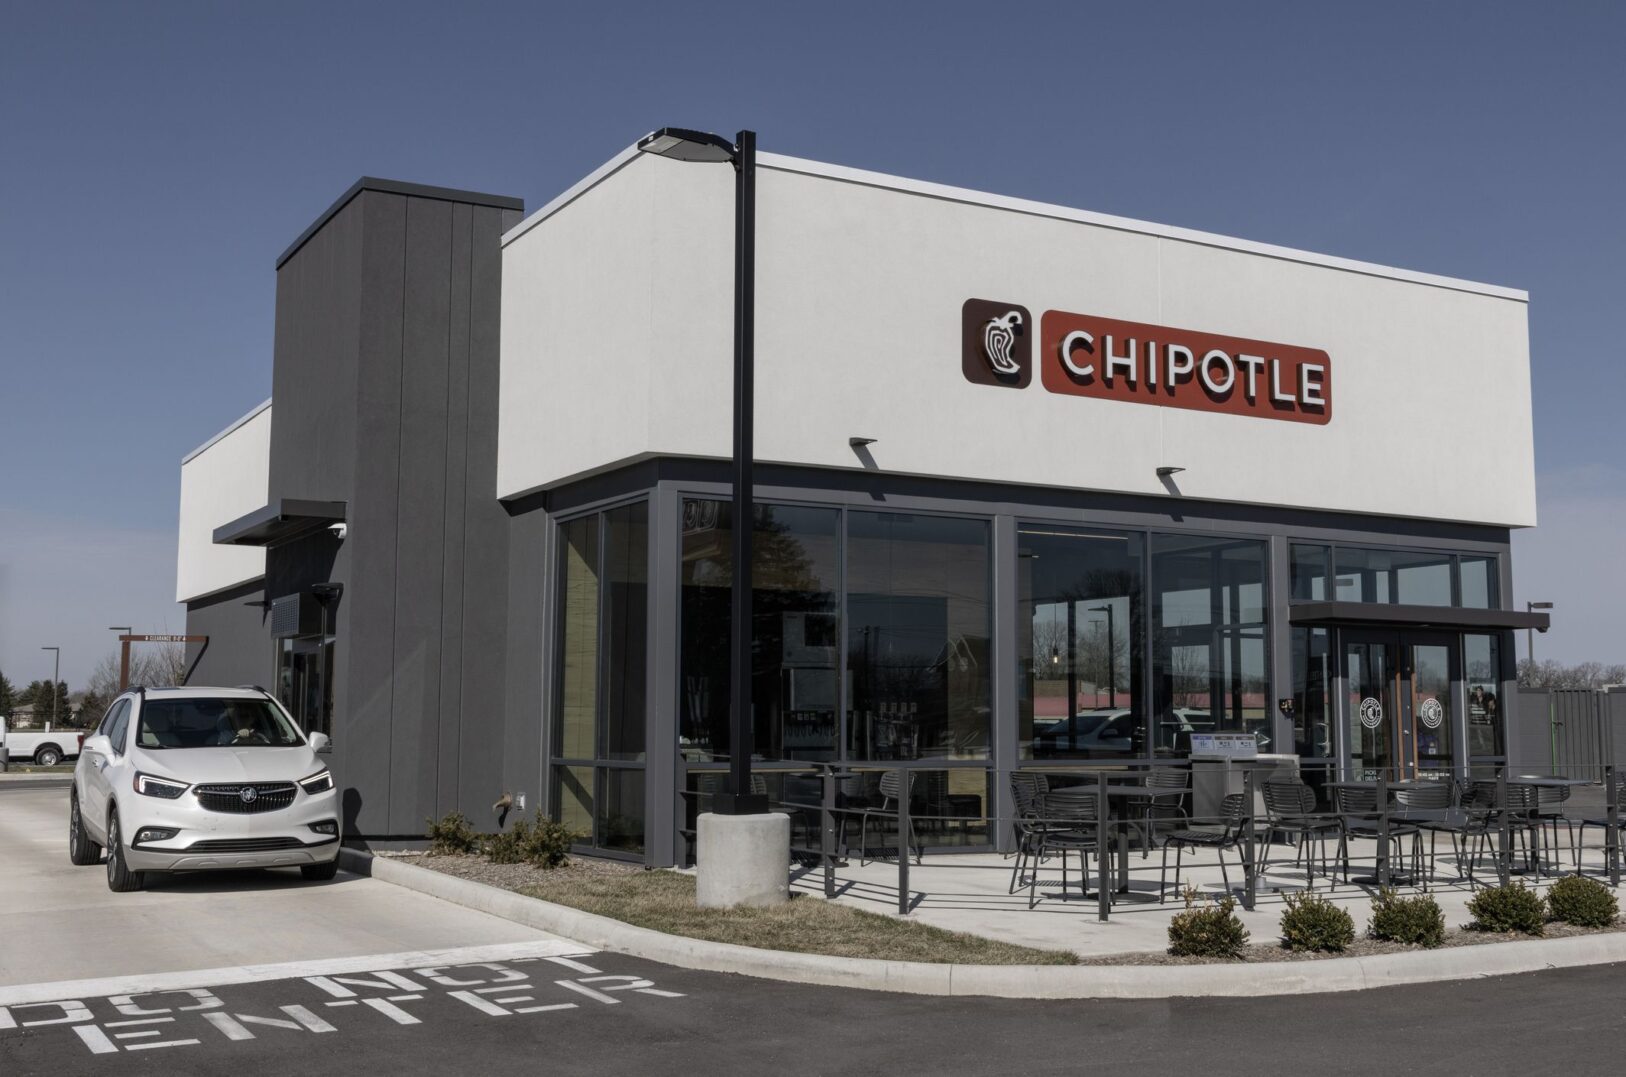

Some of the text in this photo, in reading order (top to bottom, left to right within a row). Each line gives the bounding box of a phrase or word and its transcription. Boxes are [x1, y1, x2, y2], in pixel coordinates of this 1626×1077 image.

[1061, 329, 1326, 406] CHIPOTLE
[0, 953, 603, 1029] DO NOT
[72, 974, 688, 1055] ENTER
